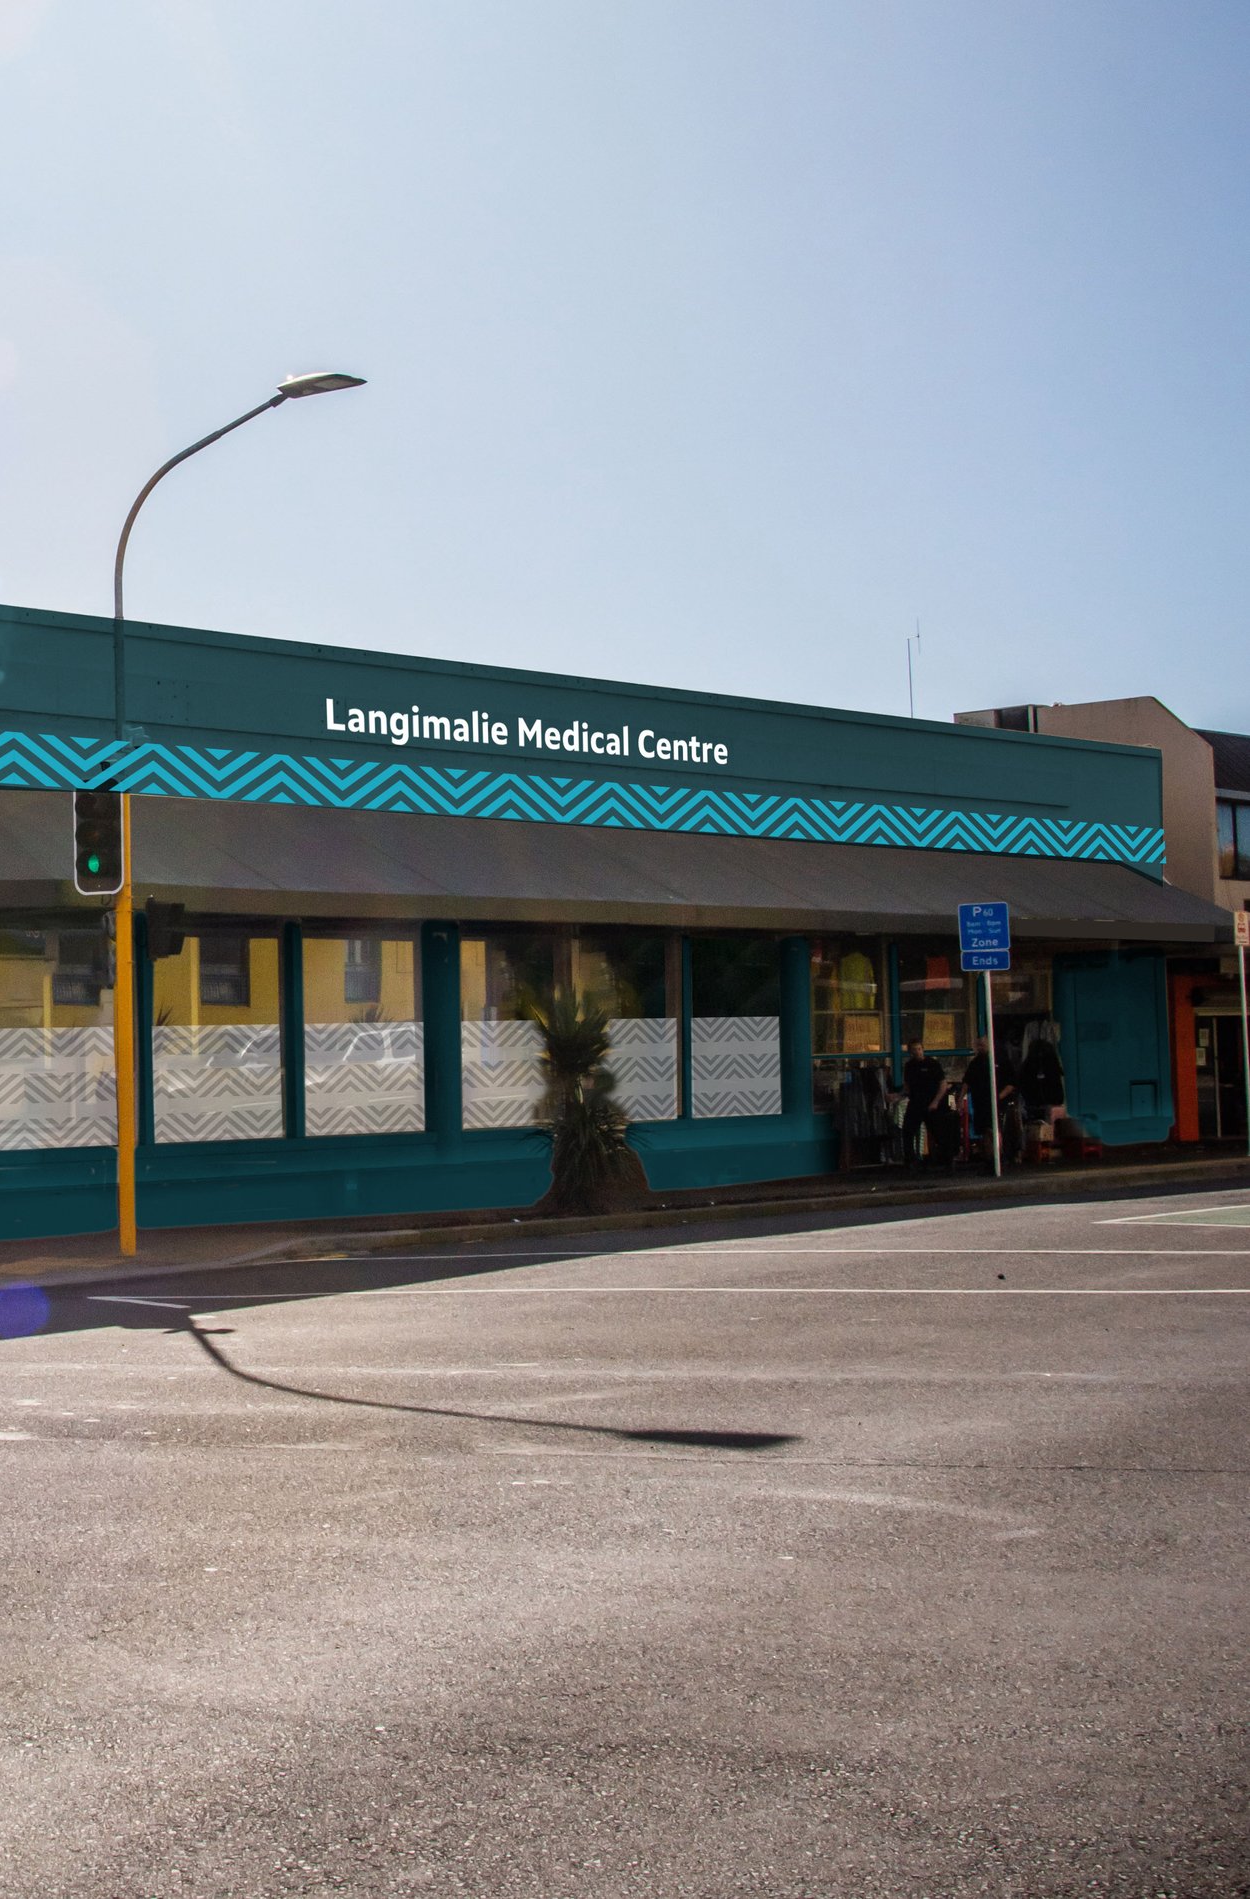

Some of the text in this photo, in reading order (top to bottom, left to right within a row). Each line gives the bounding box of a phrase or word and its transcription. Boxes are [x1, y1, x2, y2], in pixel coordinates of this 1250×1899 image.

[326, 698, 729, 765] Langimalie Medical Centre
[972, 938, 999, 947] Zone
[972, 956, 999, 966] Ends
